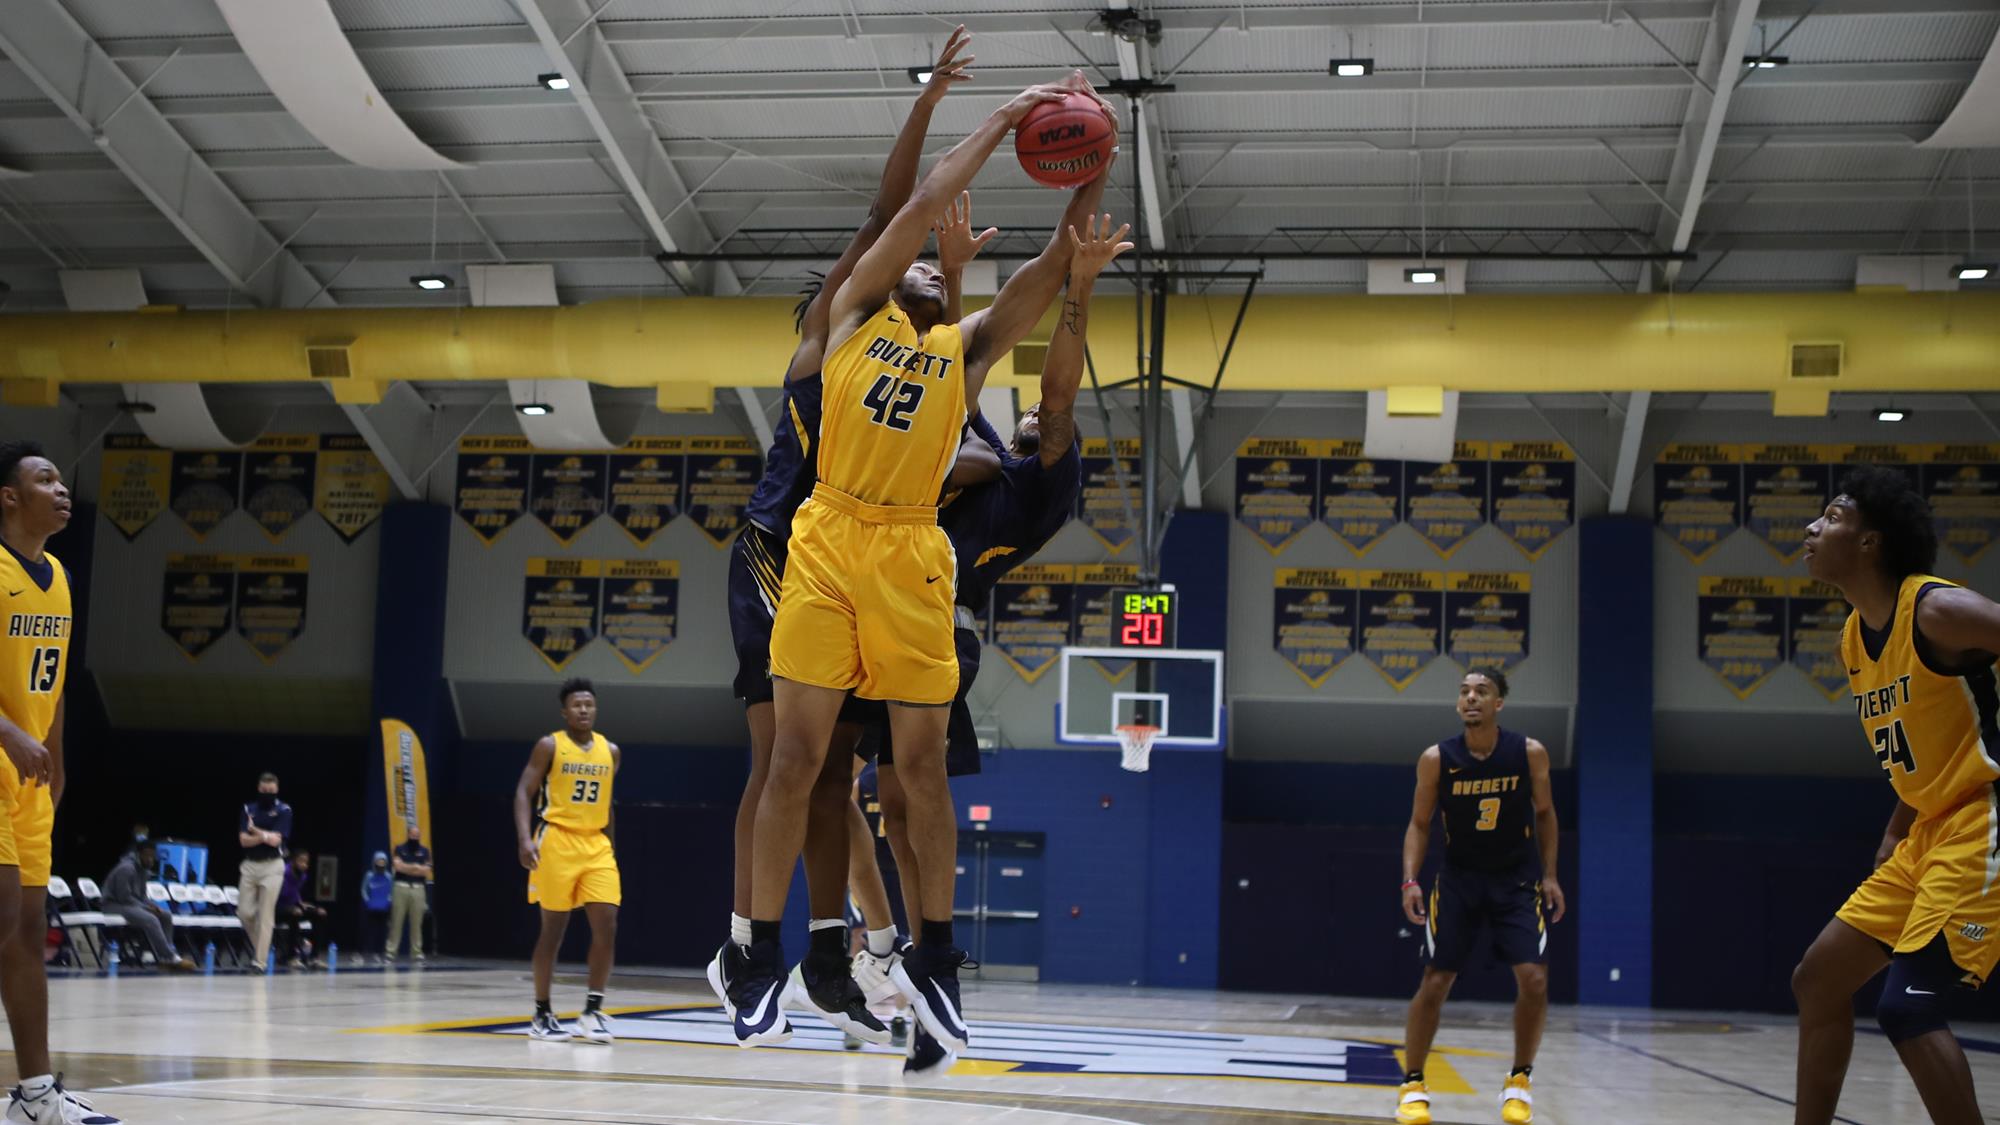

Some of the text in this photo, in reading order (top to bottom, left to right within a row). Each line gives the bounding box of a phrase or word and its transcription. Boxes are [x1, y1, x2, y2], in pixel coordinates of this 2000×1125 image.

[1039, 124, 1086, 145] NCAA
[1036, 149, 1101, 174] Wilson
[863, 374, 925, 433] 42
[1085, 573, 1137, 582] BASKETBA
[1285, 577, 1347, 586] VOLLEYBALL
[1370, 579, 1433, 588] VOLLEYBALL
[1123, 593, 1170, 615] 13:47
[1121, 613, 1164, 646] 20
[29, 646, 61, 694] 13
[1873, 718, 1918, 781] 24
[560, 762, 609, 776] AVERETT
[570, 779, 600, 804] 33
[1451, 775, 1521, 796] AVERETT
[1474, 796, 1502, 832] 3
